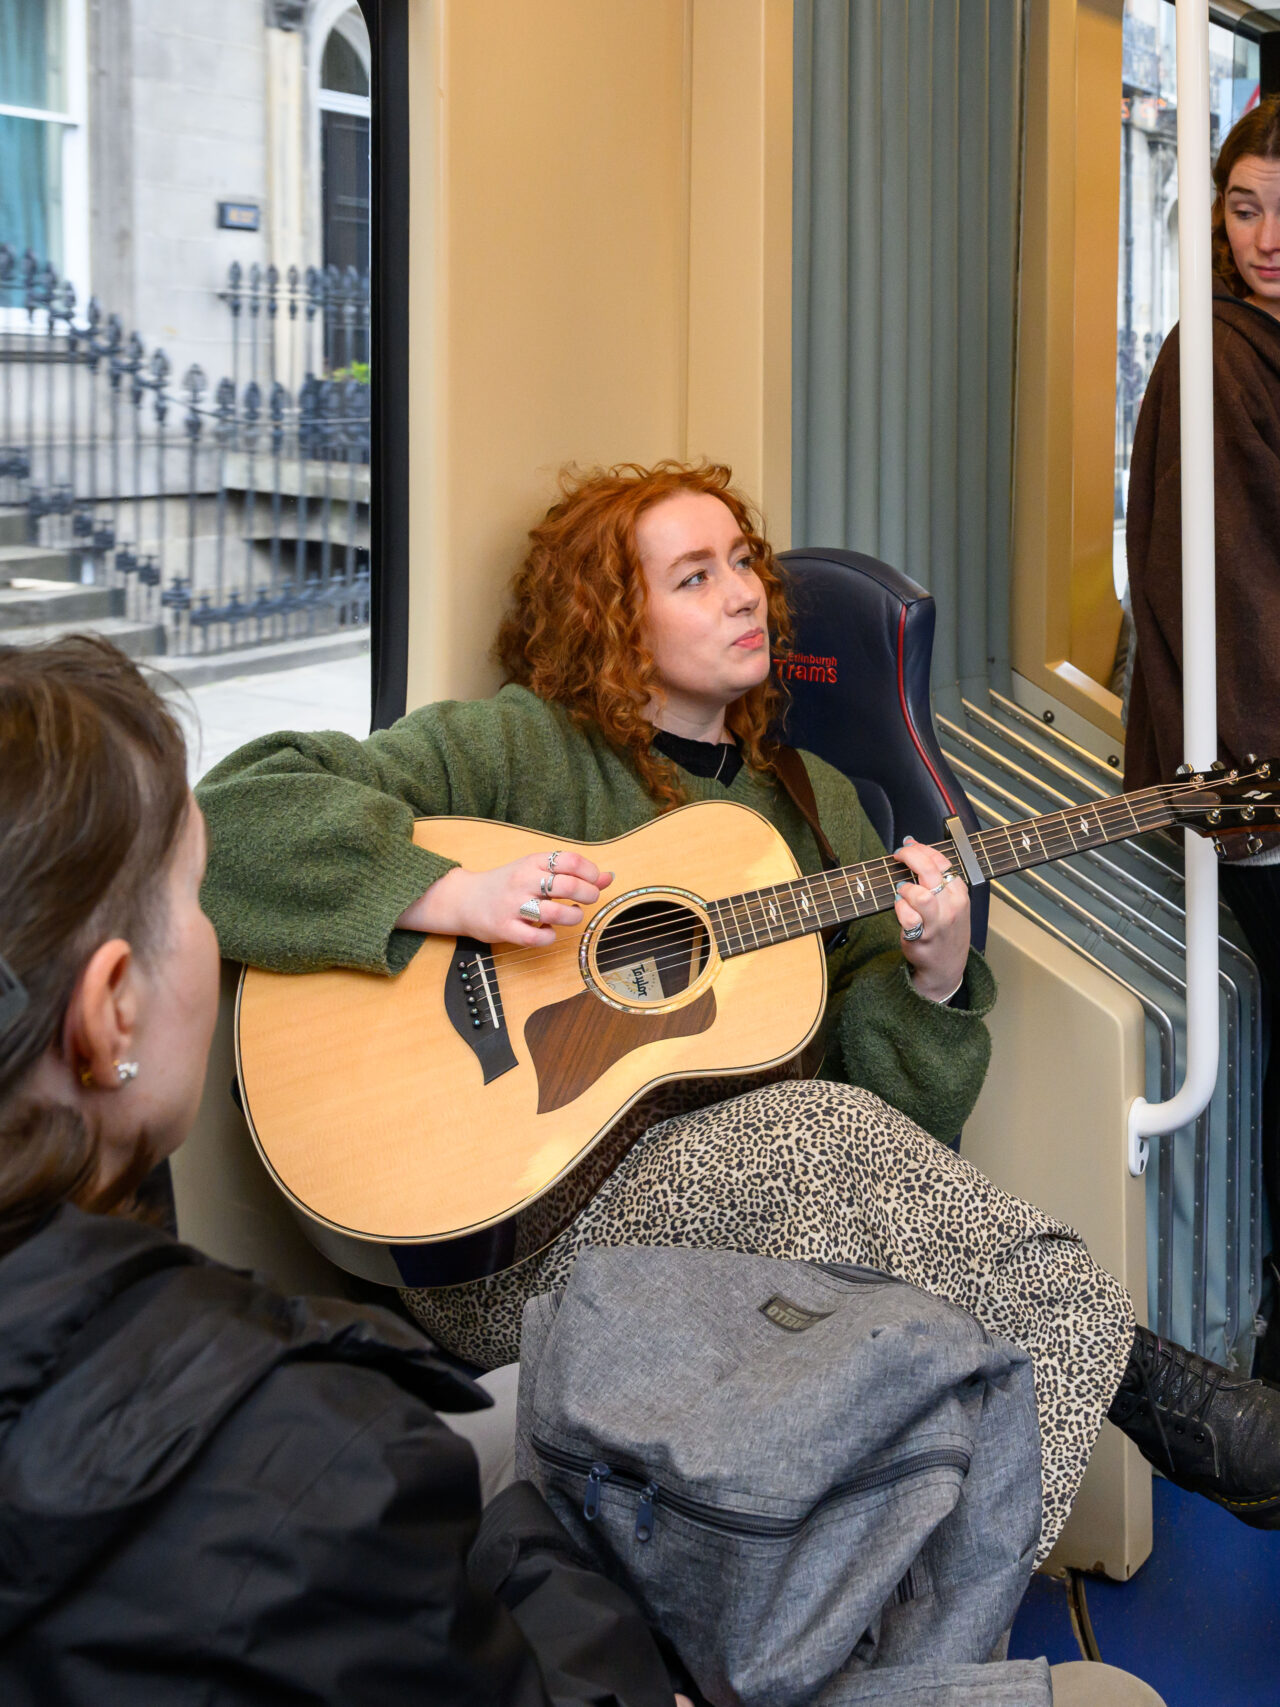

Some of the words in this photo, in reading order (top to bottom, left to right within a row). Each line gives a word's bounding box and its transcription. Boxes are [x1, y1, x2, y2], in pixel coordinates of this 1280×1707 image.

[772, 658, 838, 684] Trams
[787, 651, 838, 668] Edinburgh
[631, 963, 649, 997] Taylor
